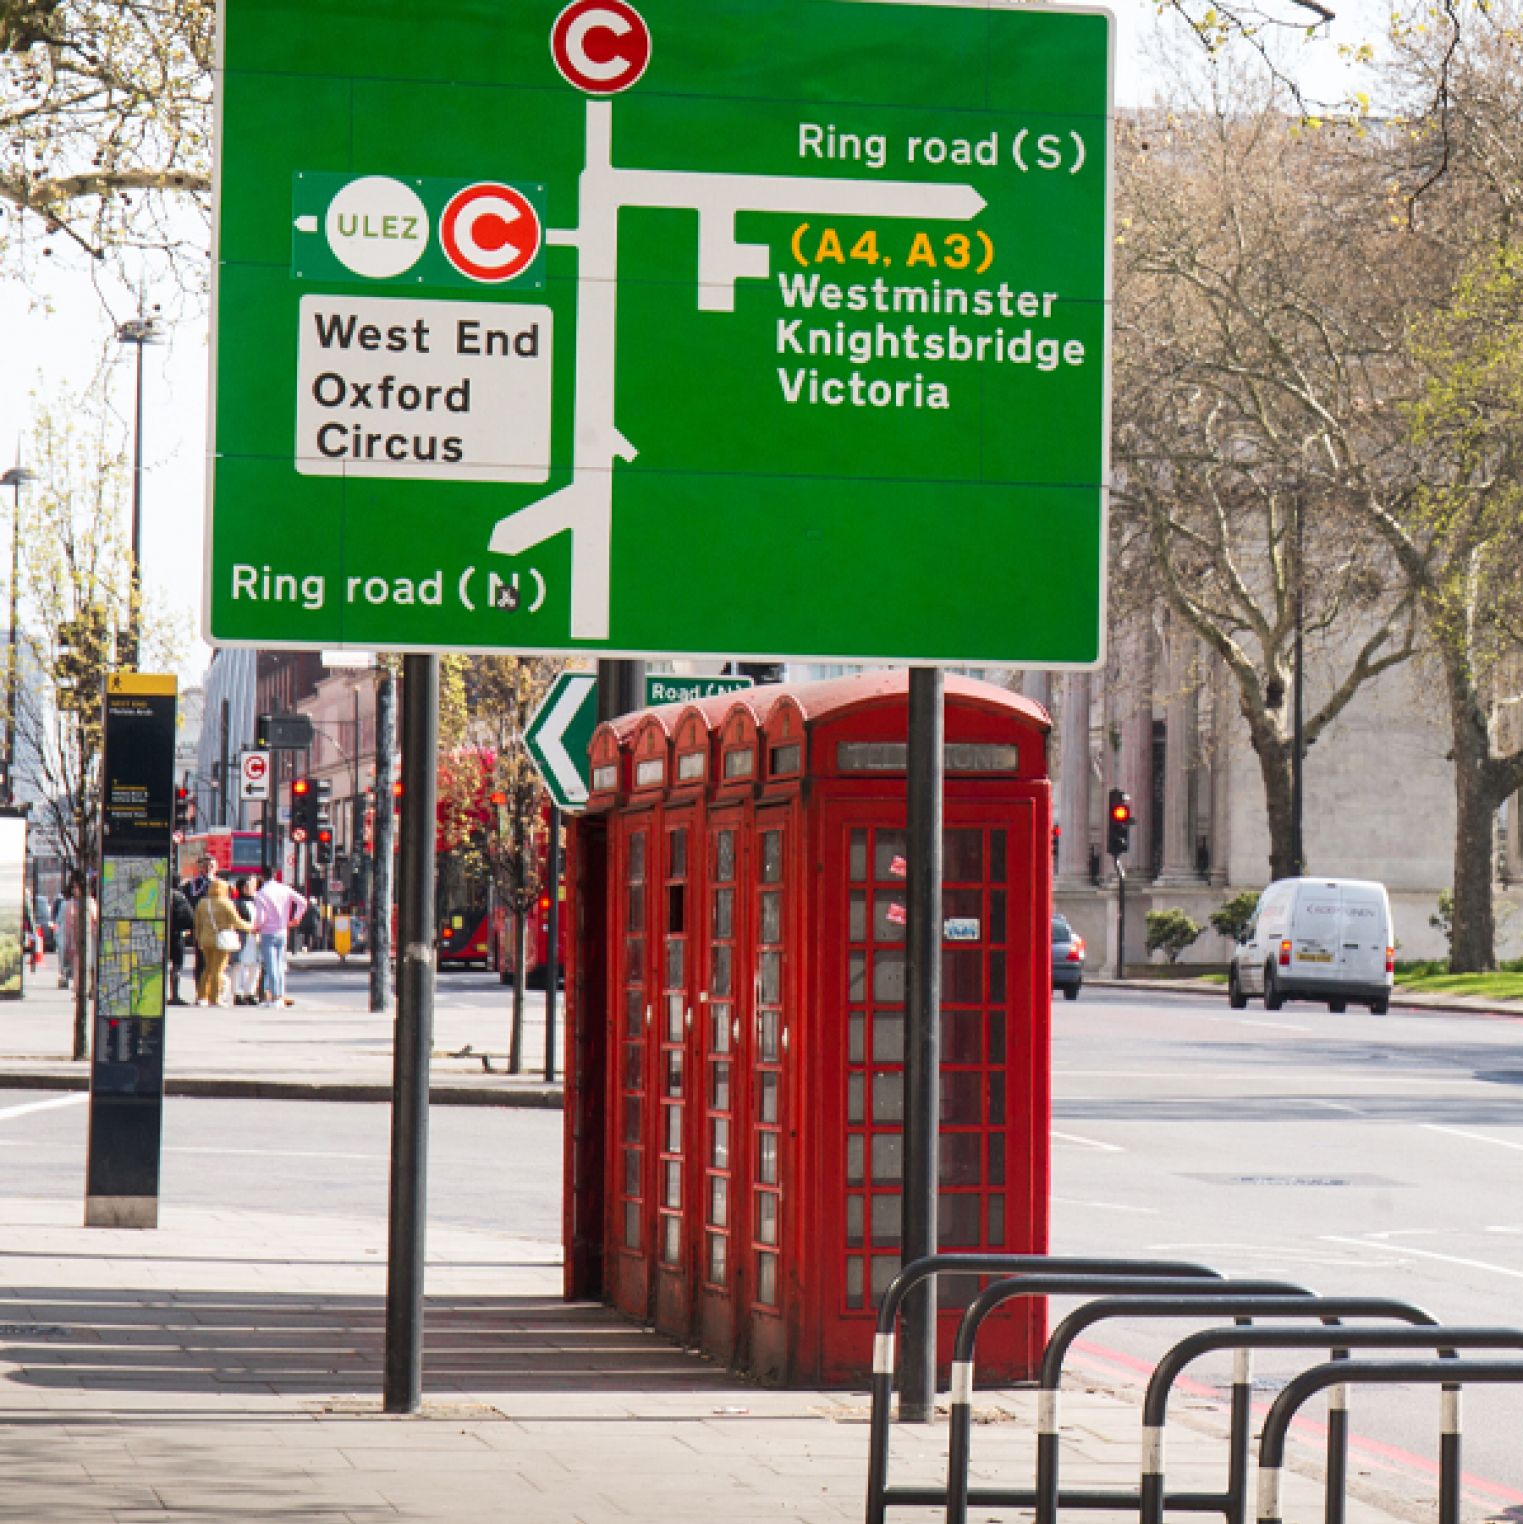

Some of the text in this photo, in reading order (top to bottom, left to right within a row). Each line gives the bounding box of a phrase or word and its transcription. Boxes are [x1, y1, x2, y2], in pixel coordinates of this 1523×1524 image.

[799, 123, 1086, 174] Ring road (S)
[337, 213, 419, 240] ULEZ
[906, 230, 994, 274] A3)
[778, 272, 1059, 318] Westminster
[314, 313, 540, 358] West End
[776, 318, 1086, 371] Knightsbridge
[311, 372, 471, 412] Oxford
[777, 366, 950, 410] Victoria
[316, 422, 464, 463] Circus
[232, 564, 325, 610] Ring
[347, 569, 443, 605] road
[652, 682, 700, 700] Road
